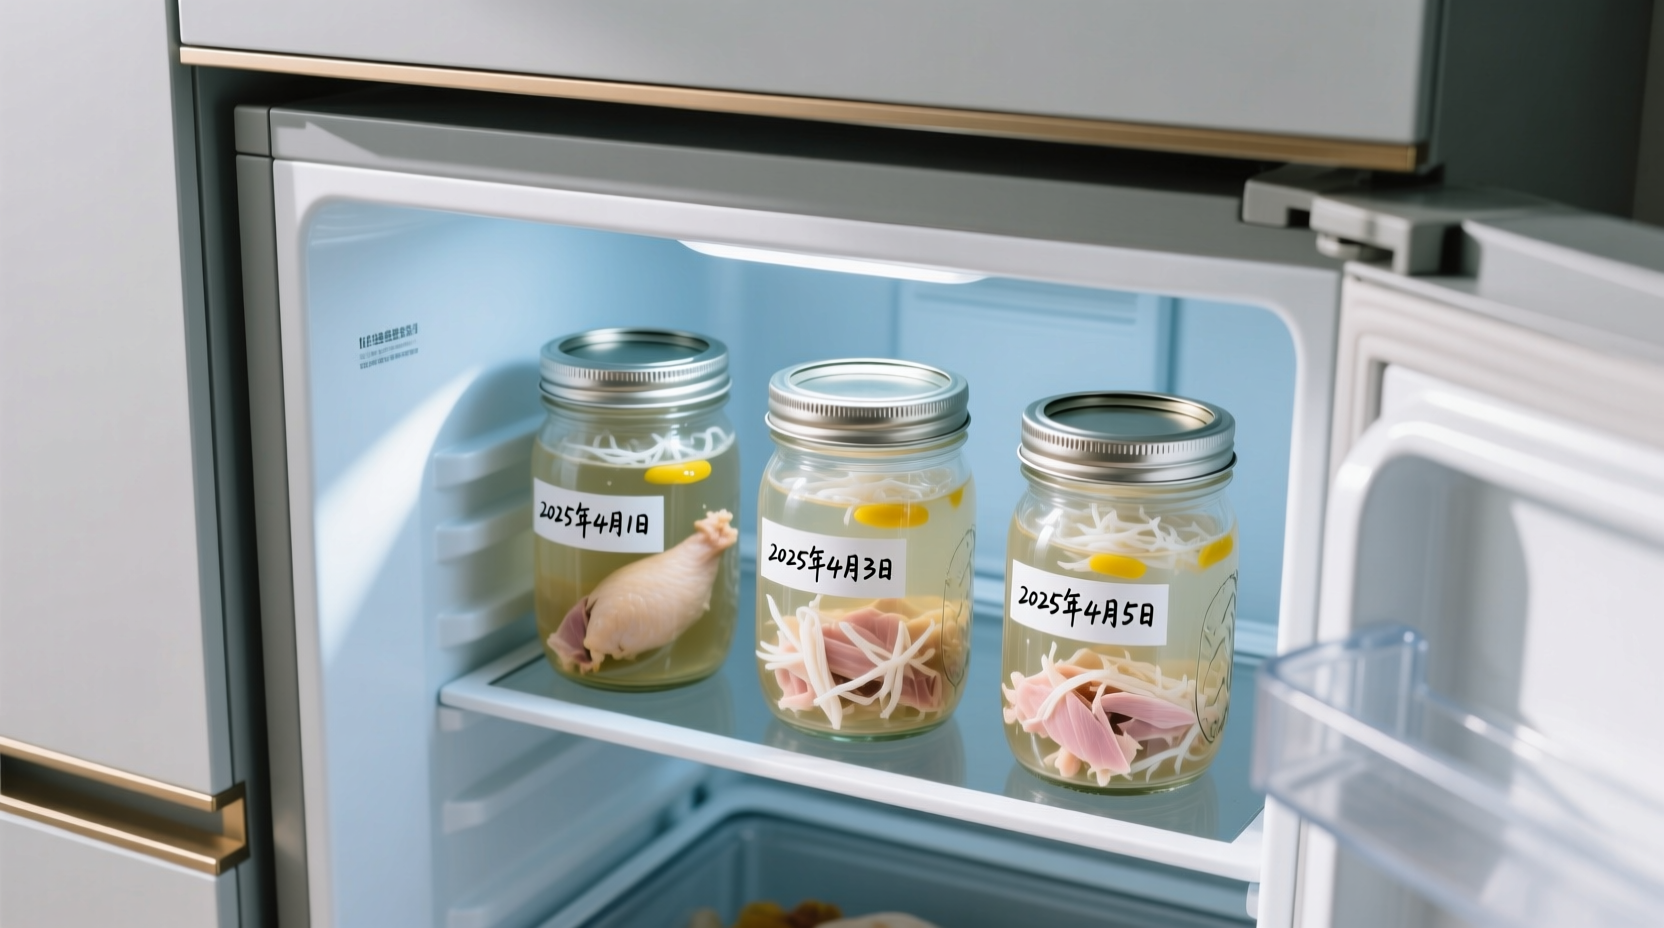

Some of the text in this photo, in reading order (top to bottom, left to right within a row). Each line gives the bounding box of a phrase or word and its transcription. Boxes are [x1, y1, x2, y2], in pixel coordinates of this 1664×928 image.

[539, 501, 649, 539] 2025年4月1日
[768, 543, 892, 583] 2025年4月3日
[1018, 585, 1154, 628] 2025年4月5日
